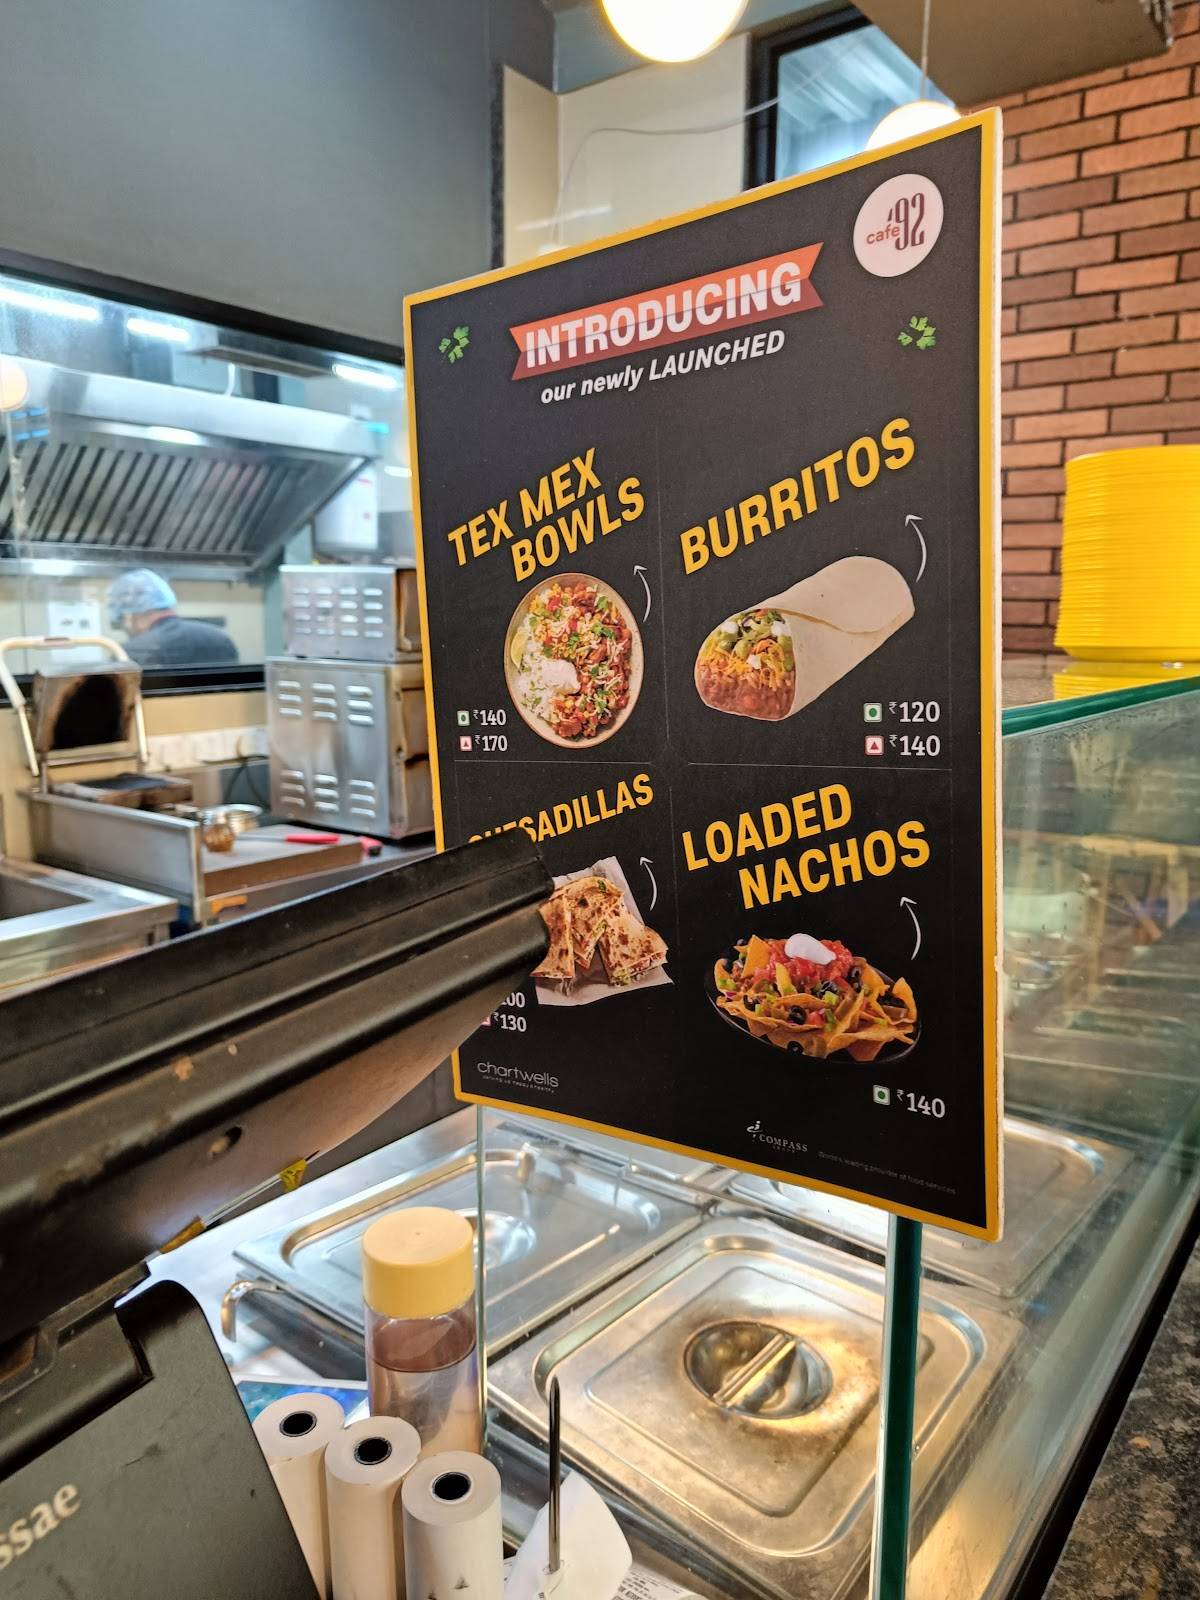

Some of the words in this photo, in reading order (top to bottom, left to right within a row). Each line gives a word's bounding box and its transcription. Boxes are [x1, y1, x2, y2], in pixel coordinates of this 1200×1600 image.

[525, 261, 802, 369] INTRODUCING
[541, 381, 576, 404] our
[580, 364, 644, 392] newly
[648, 329, 786, 381] LAUNCHED
[447, 499, 514, 567] TEX
[519, 447, 602, 529] MEX
[679, 417, 915, 576] BURRITOS
[511, 476, 645, 583] BOWLS
[472, 708, 507, 726] ₹140
[888, 700, 941, 723] ₹120
[474, 734, 508, 752] ₹170
[888, 734, 941, 757] ₹140
[467, 772, 655, 844] SADILLAS
[681, 783, 853, 872] LOADED
[738, 820, 931, 910] NACHOS
[501, 991, 526, 1008] 00
[476, 1060, 560, 1088] chartwells
[896, 1088, 946, 1118] ₹140
[759, 1133, 809, 1153] COMPASS
